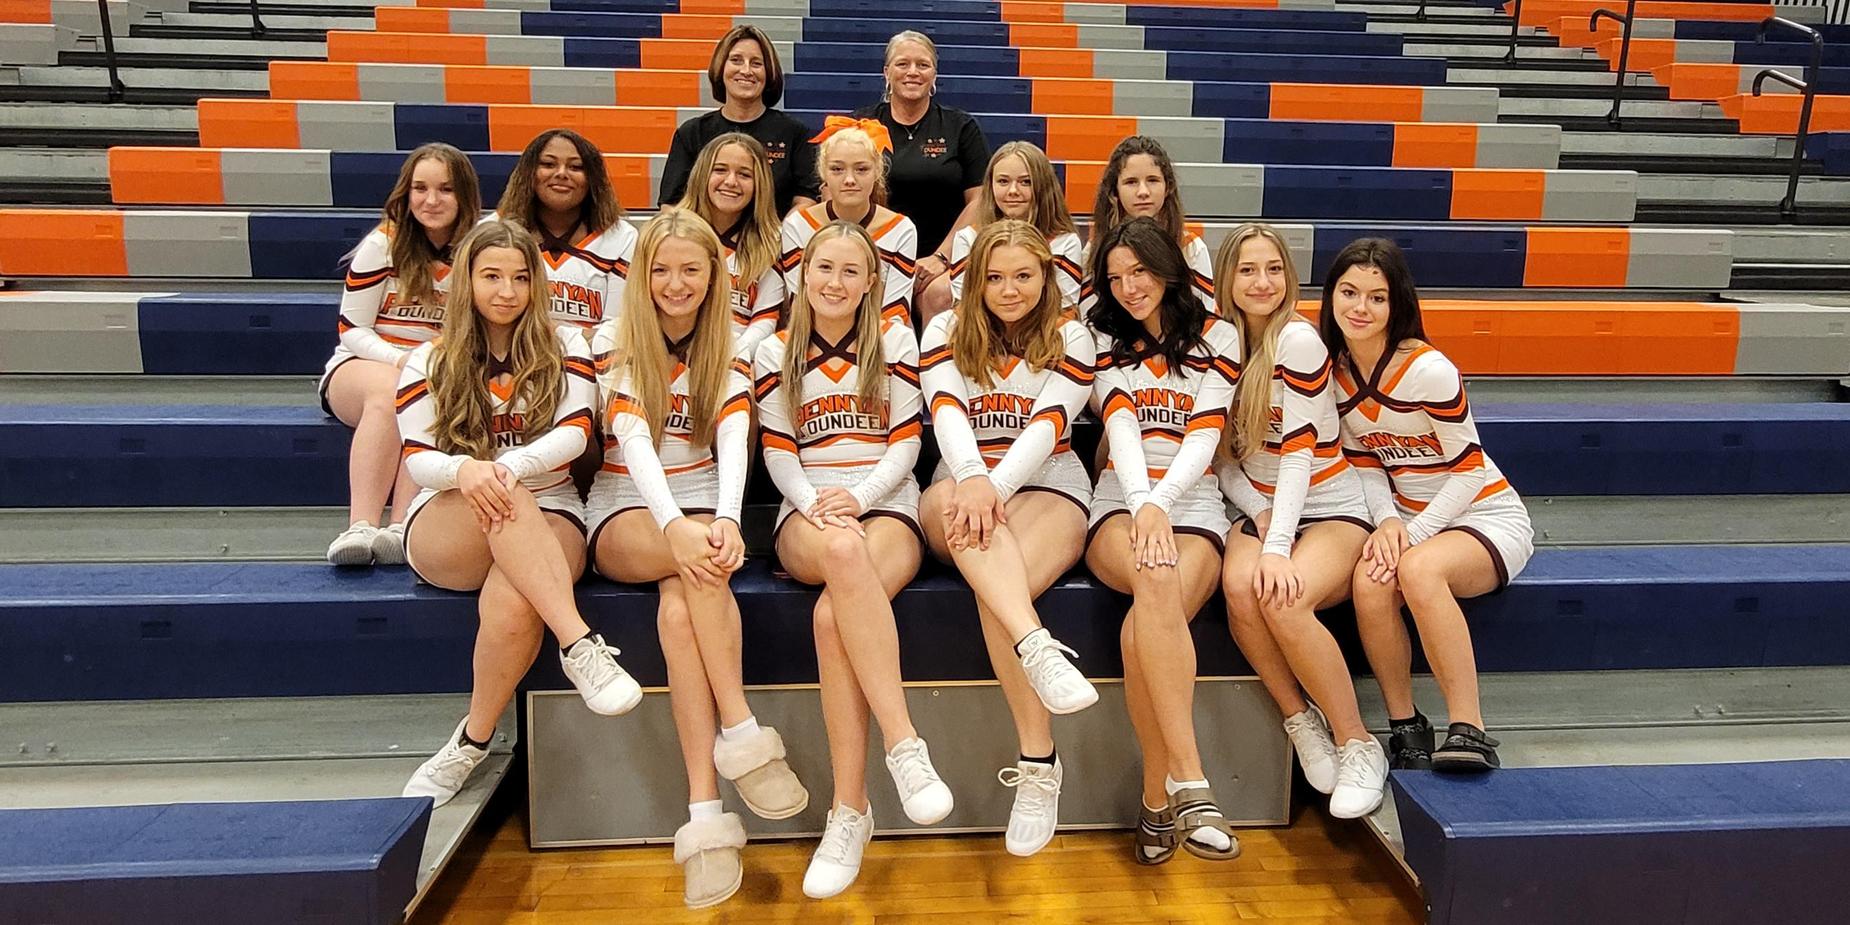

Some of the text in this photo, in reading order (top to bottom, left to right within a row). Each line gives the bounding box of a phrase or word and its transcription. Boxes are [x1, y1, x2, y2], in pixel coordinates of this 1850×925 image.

[547, 280, 603, 321] NYAN
[550, 299, 589, 318] DEE
[968, 392, 1037, 417] ENNY
[1131, 387, 1195, 413] NNYA
[807, 413, 880, 435] DUNDEE
[969, 413, 1030, 430] DUNDE
[1136, 407, 1191, 427] UNDEE
[1359, 431, 1445, 457] NNYAN
[1376, 446, 1437, 461] NDEE
